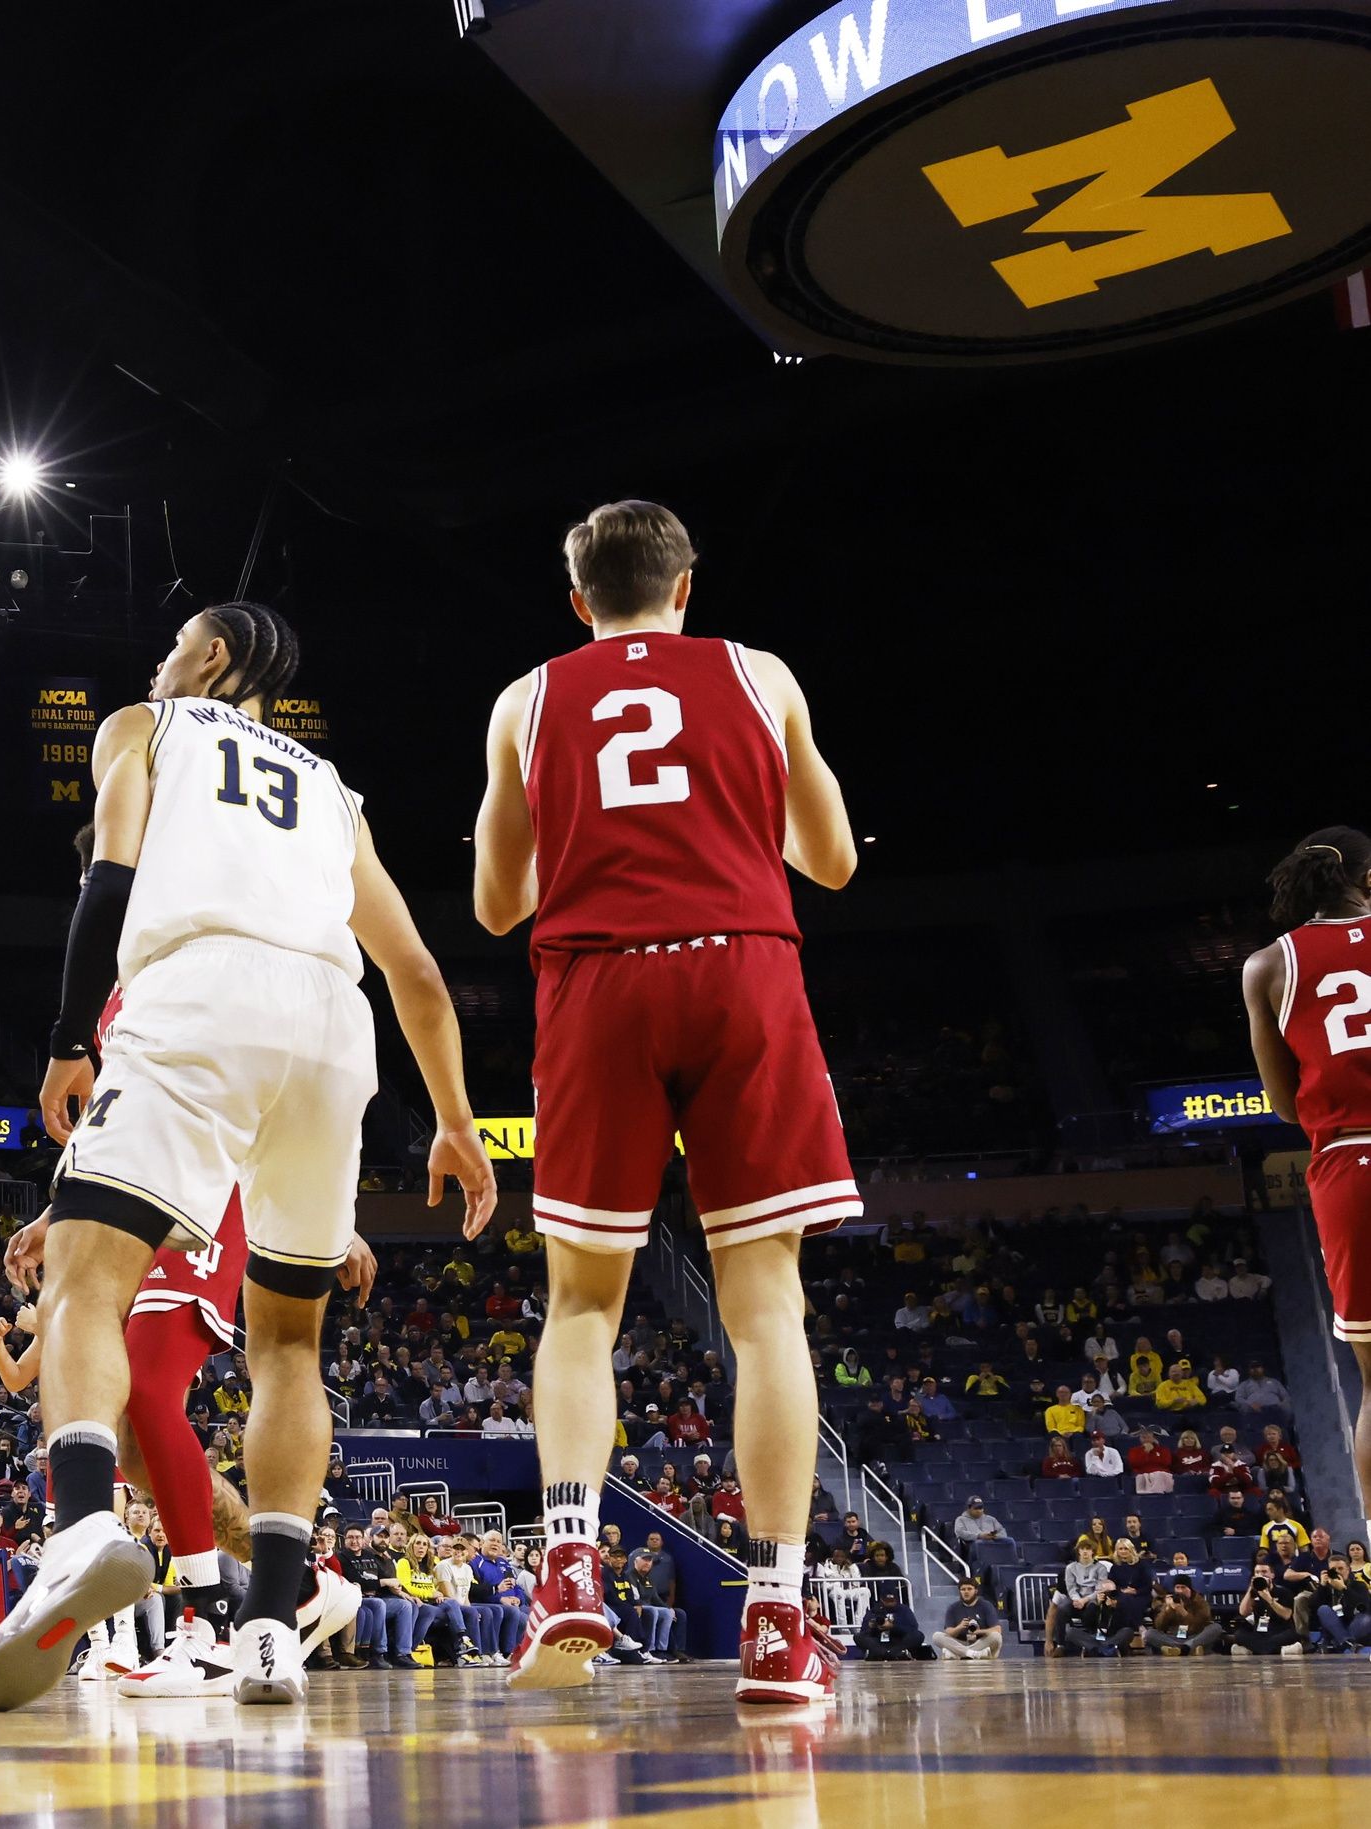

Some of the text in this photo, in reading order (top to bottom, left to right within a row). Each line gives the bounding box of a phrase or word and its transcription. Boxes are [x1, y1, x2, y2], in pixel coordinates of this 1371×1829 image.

[722, 0, 889, 210] NOW
[39, 690, 87, 705] NCAA
[274, 699, 320, 714] NCAA
[31, 708, 96, 721] FINAL FOUR
[270, 717, 329, 730] INAL FOUR
[53, 722, 96, 731] BASKETBALL
[186, 706, 319, 770] NKAMHOUA
[591, 686, 691, 810] 2
[42, 744, 88, 763] 1989
[51, 780, 80, 801] M
[217, 737, 298, 830] 13
[1315, 969, 1371, 1056] 2
[399, 1457, 449, 1470] TUNNEL
[756, 1616, 767, 1662] adidas
